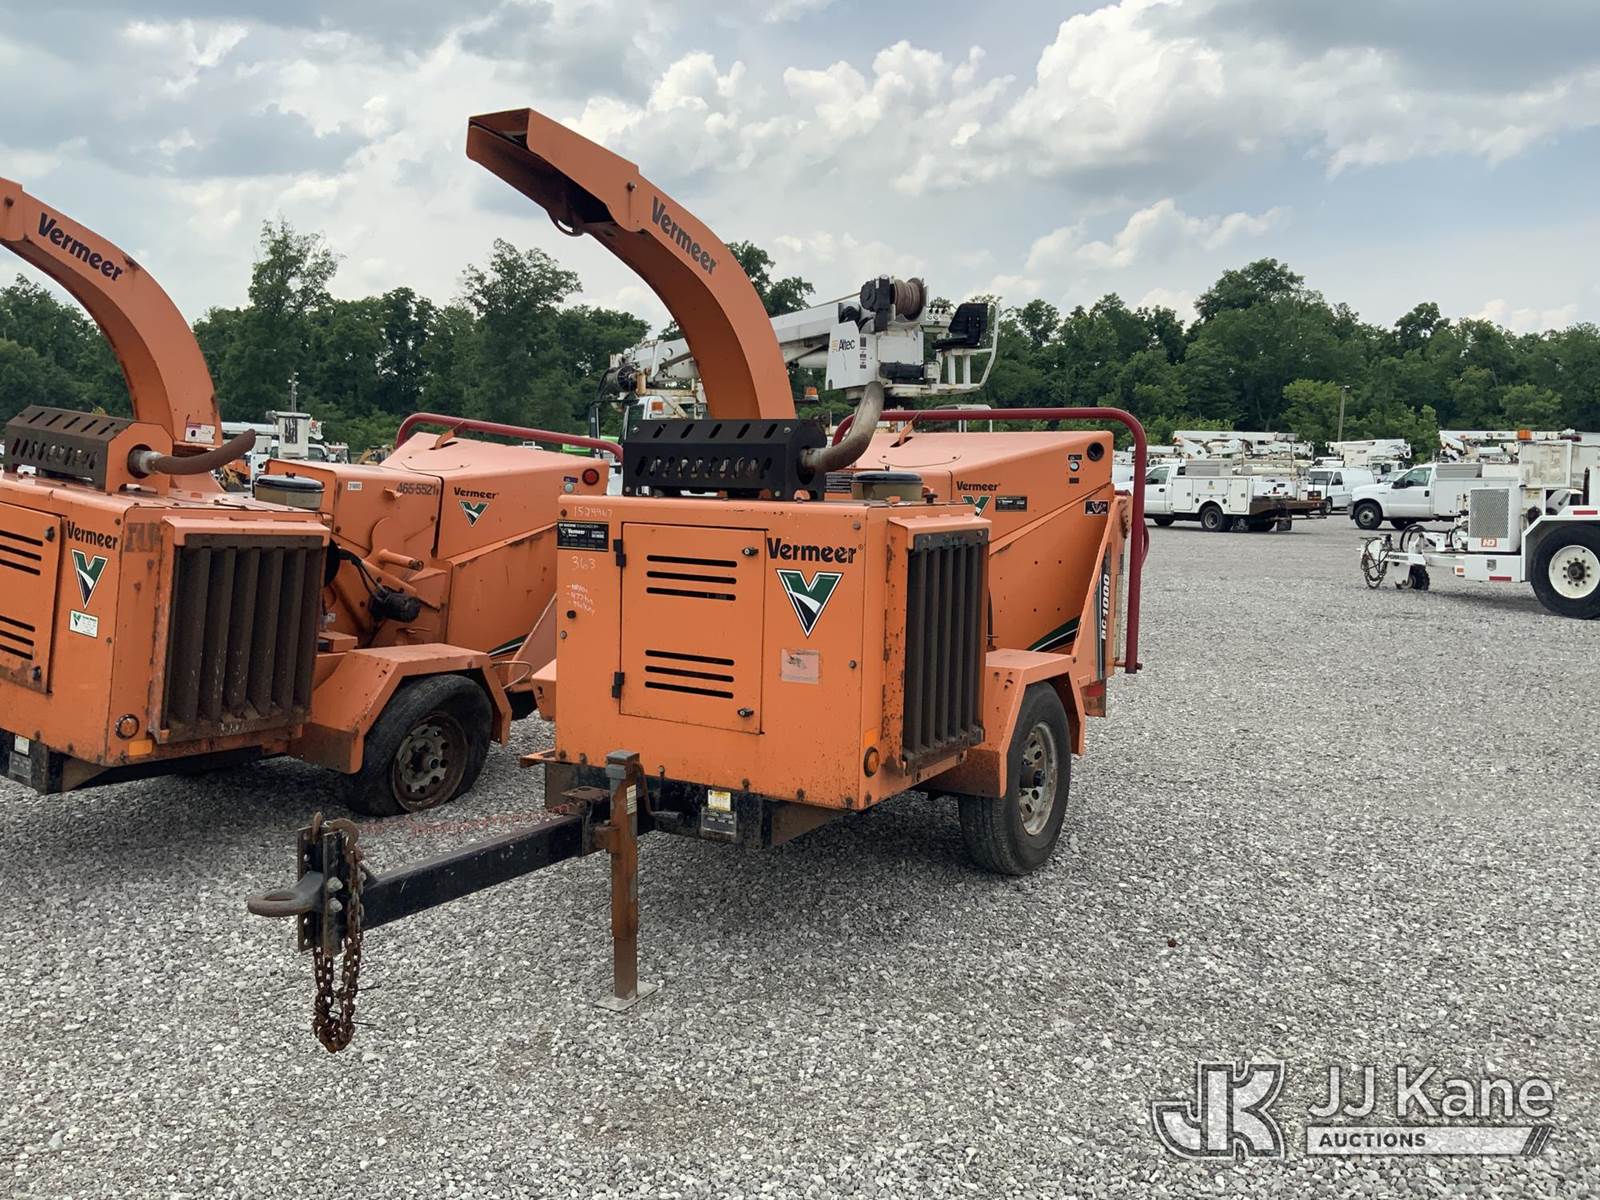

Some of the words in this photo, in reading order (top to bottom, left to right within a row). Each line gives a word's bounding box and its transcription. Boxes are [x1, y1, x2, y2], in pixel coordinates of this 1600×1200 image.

[38, 211, 123, 281] Vermeer
[652, 196, 716, 275] Vermeer
[453, 486, 497, 500] Vermeer
[956, 481, 998, 491] Vermeer
[66, 520, 119, 550] Vermeer
[767, 537, 857, 564] Vermeer
